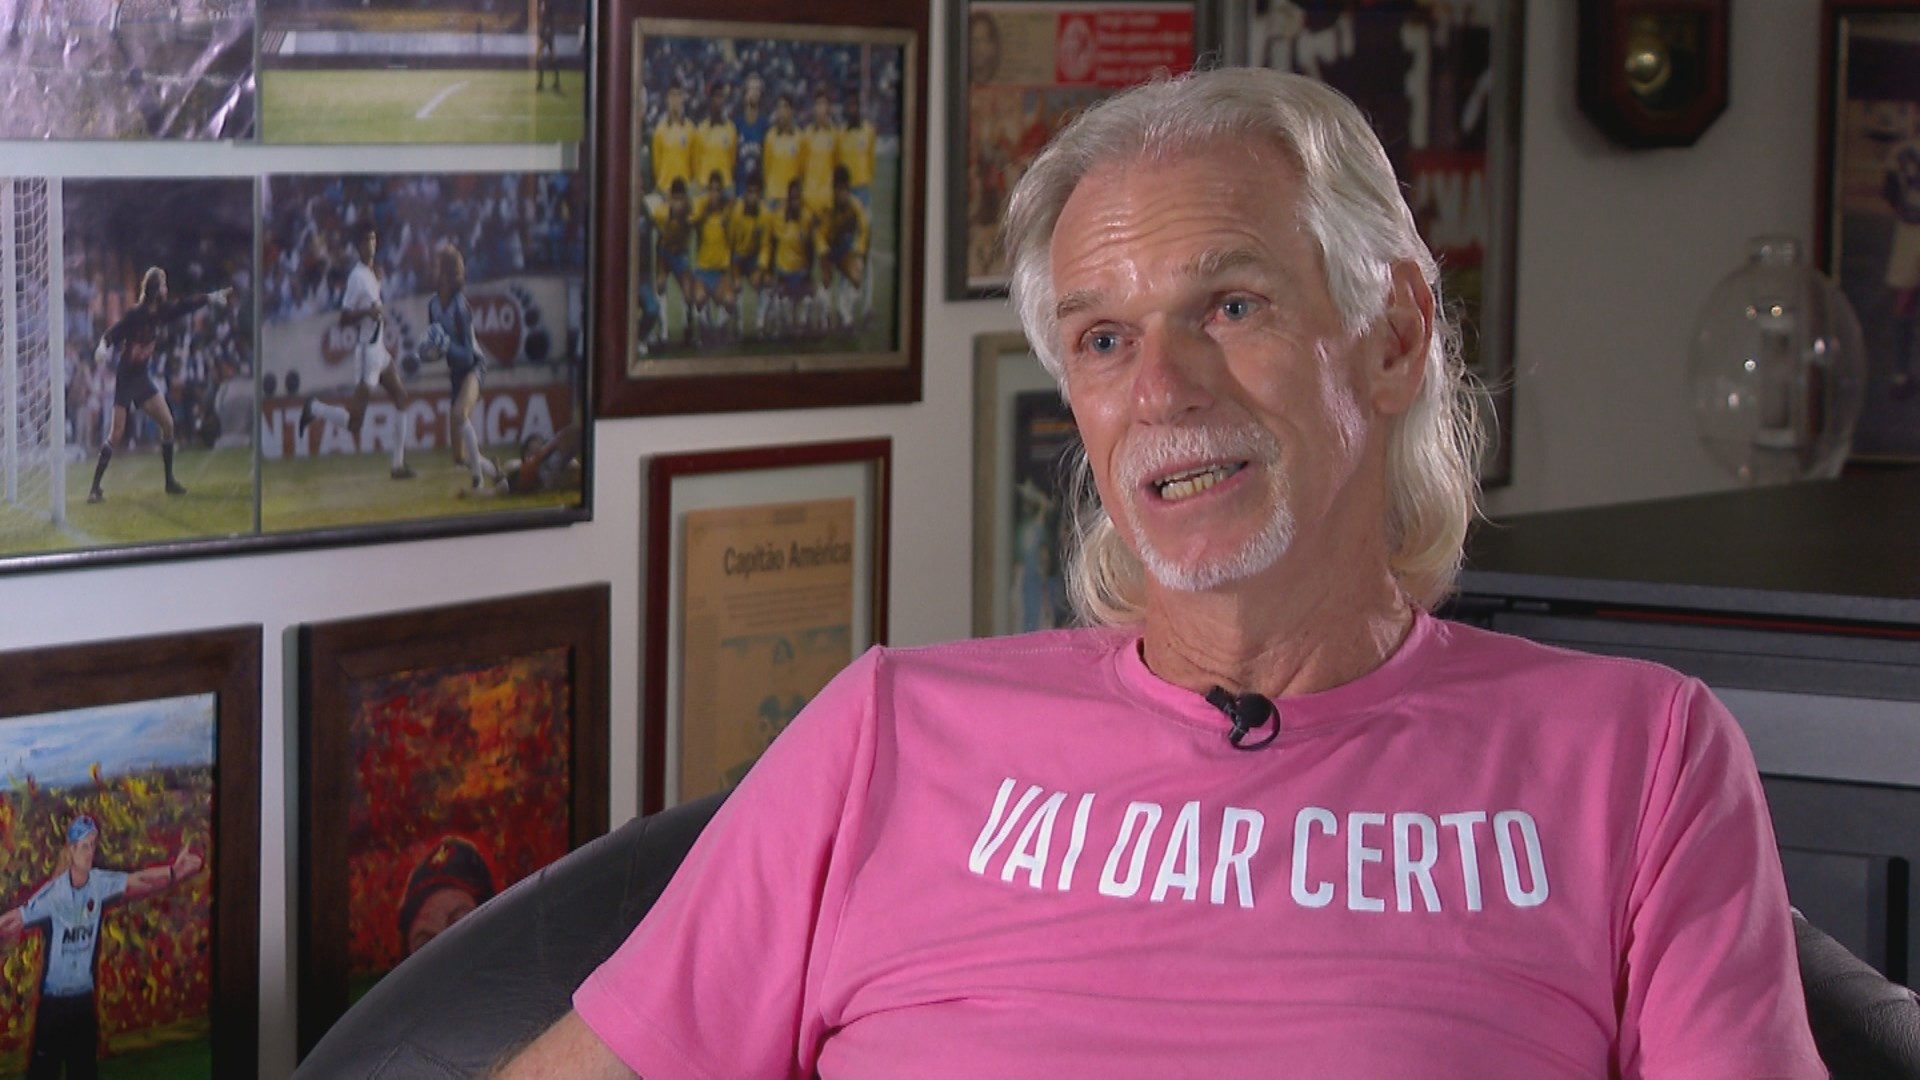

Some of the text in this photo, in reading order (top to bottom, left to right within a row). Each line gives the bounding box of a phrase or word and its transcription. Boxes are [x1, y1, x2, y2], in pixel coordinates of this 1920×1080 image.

[723, 542, 785, 579] Capitão
[969, 778, 1548, 912] VAI DAR CERTO
